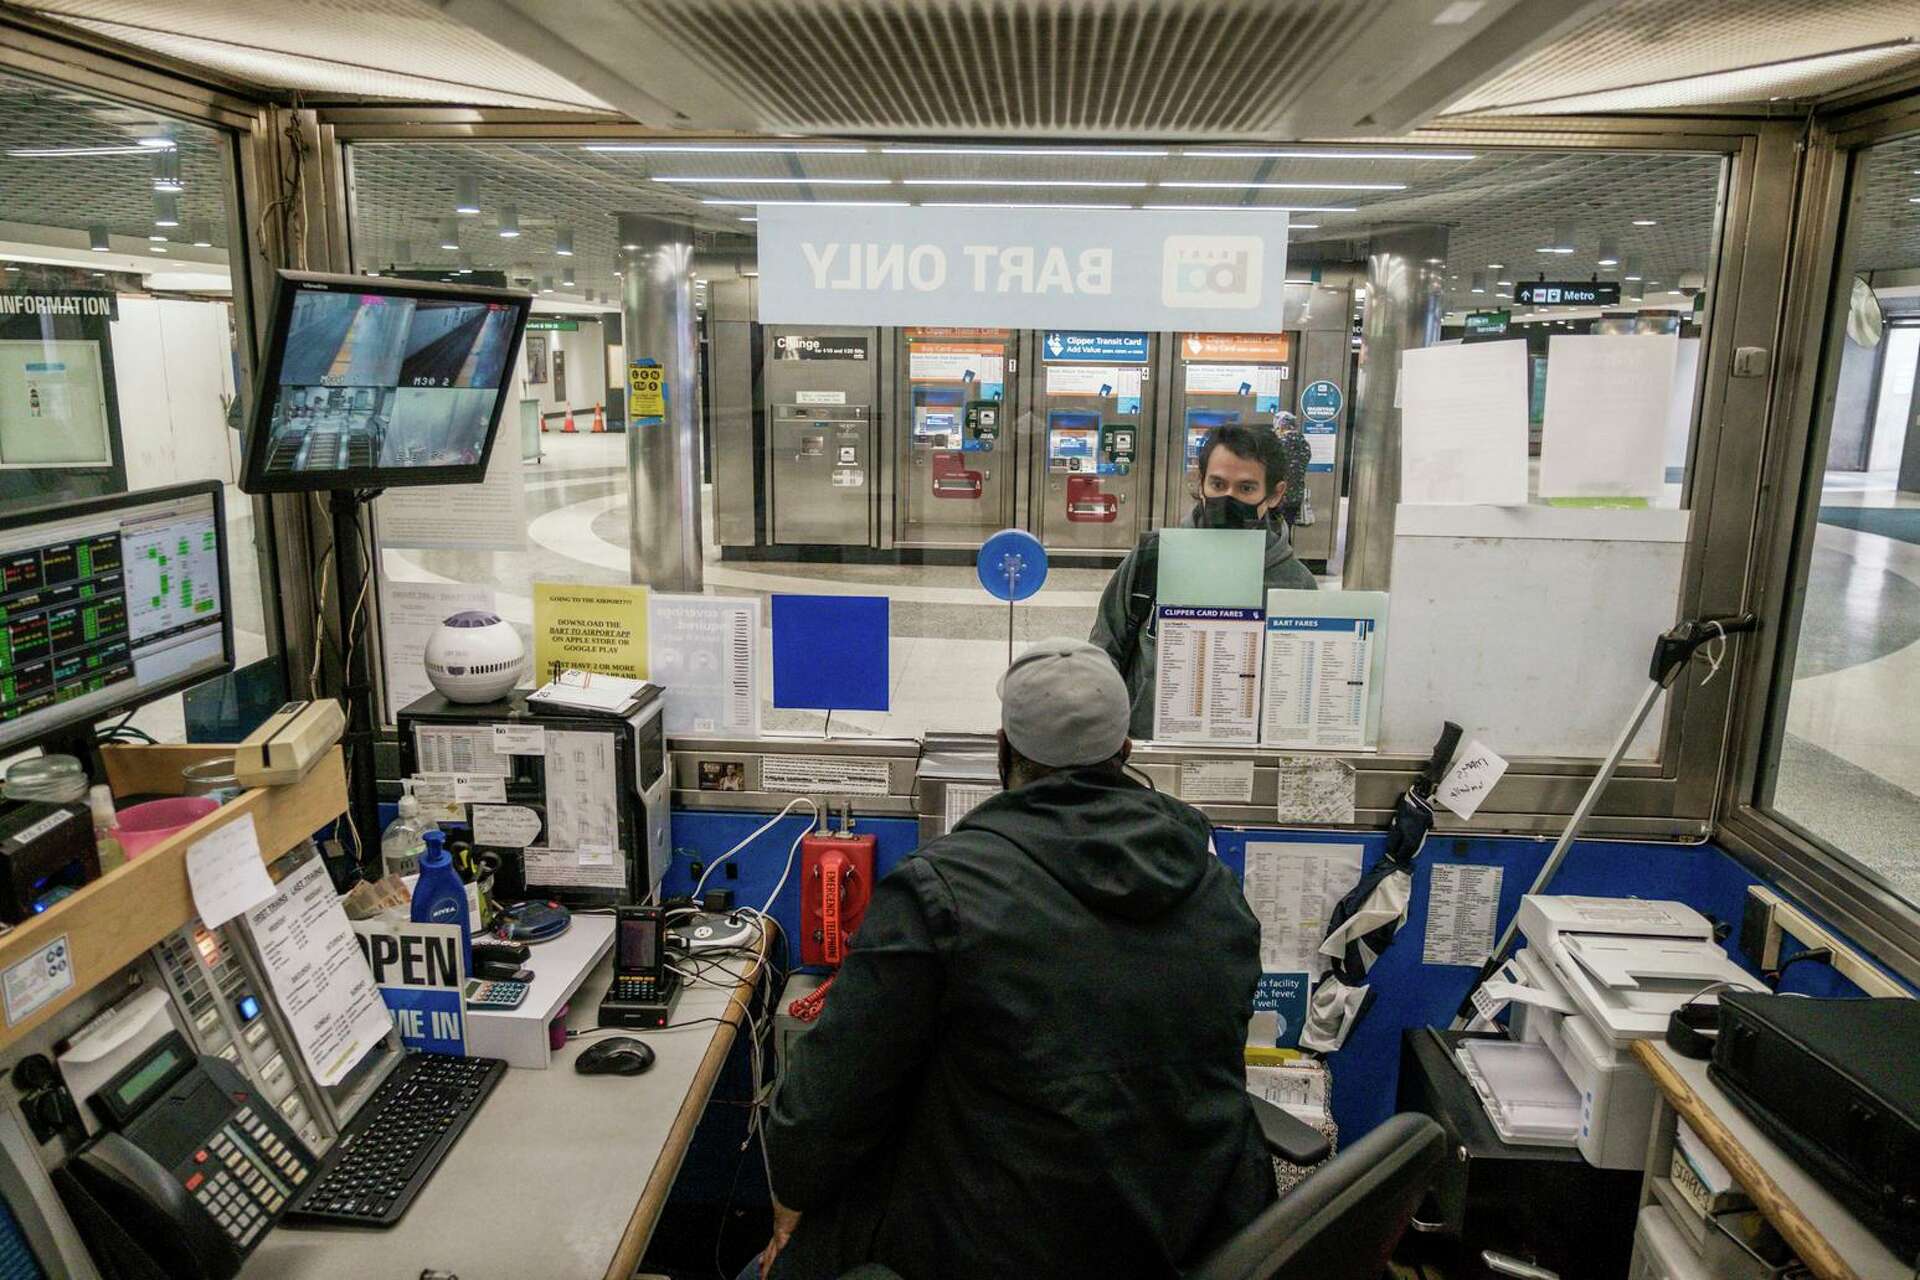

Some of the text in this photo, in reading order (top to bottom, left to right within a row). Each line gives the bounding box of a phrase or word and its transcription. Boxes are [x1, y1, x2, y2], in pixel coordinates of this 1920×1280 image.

[1564, 291, 1595, 300] Metro
[0, 295, 111, 315] INFORMATION
[1096, 336, 1122, 345] Transit
[1123, 337, 1142, 346] Card
[1164, 608, 1196, 617] CLIPPER
[1196, 609, 1218, 617] CARD
[558, 619, 604, 627] DOWNLOAD
[549, 627, 571, 635] BART
[582, 629, 613, 637] AIRPORT
[614, 630, 631, 638] APP
[564, 645, 619, 654] GOOGLE PLAY
[432, 906, 457, 917] NIVEA
[826, 871, 838, 960] EMERGENCY TELEPHONE
[1269, 979, 1300, 989] facility
[1271, 989, 1296, 998] fever,
[1257, 999, 1280, 1008] well.
[389, 1009, 461, 1040] ME IN
